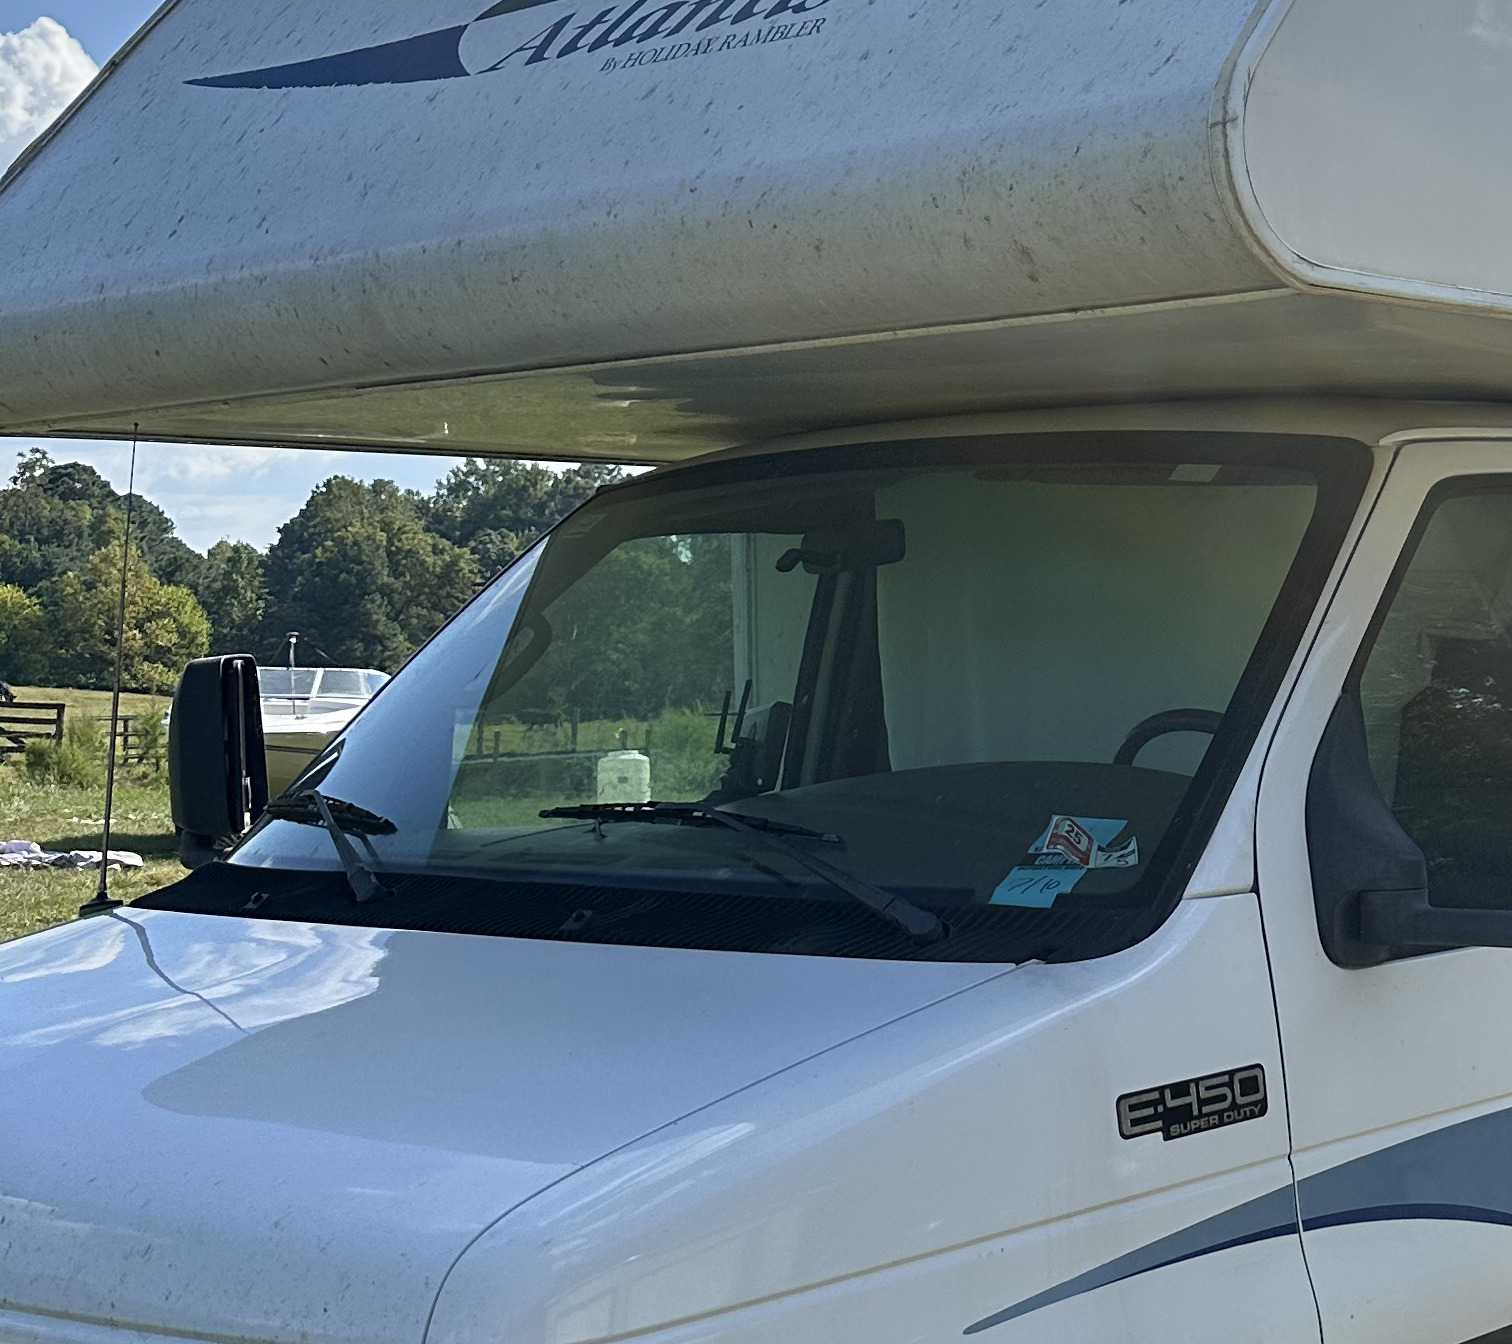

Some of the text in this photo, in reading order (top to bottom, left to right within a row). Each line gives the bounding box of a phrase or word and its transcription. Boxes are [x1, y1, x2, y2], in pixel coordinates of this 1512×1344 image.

[599, 17, 827, 75] By HOLIDAY RAMBLER
[1064, 823, 1083, 845] 25
[1119, 1067, 1265, 1136] E-450
[1169, 1103, 1262, 1137] SUPER DUTY
